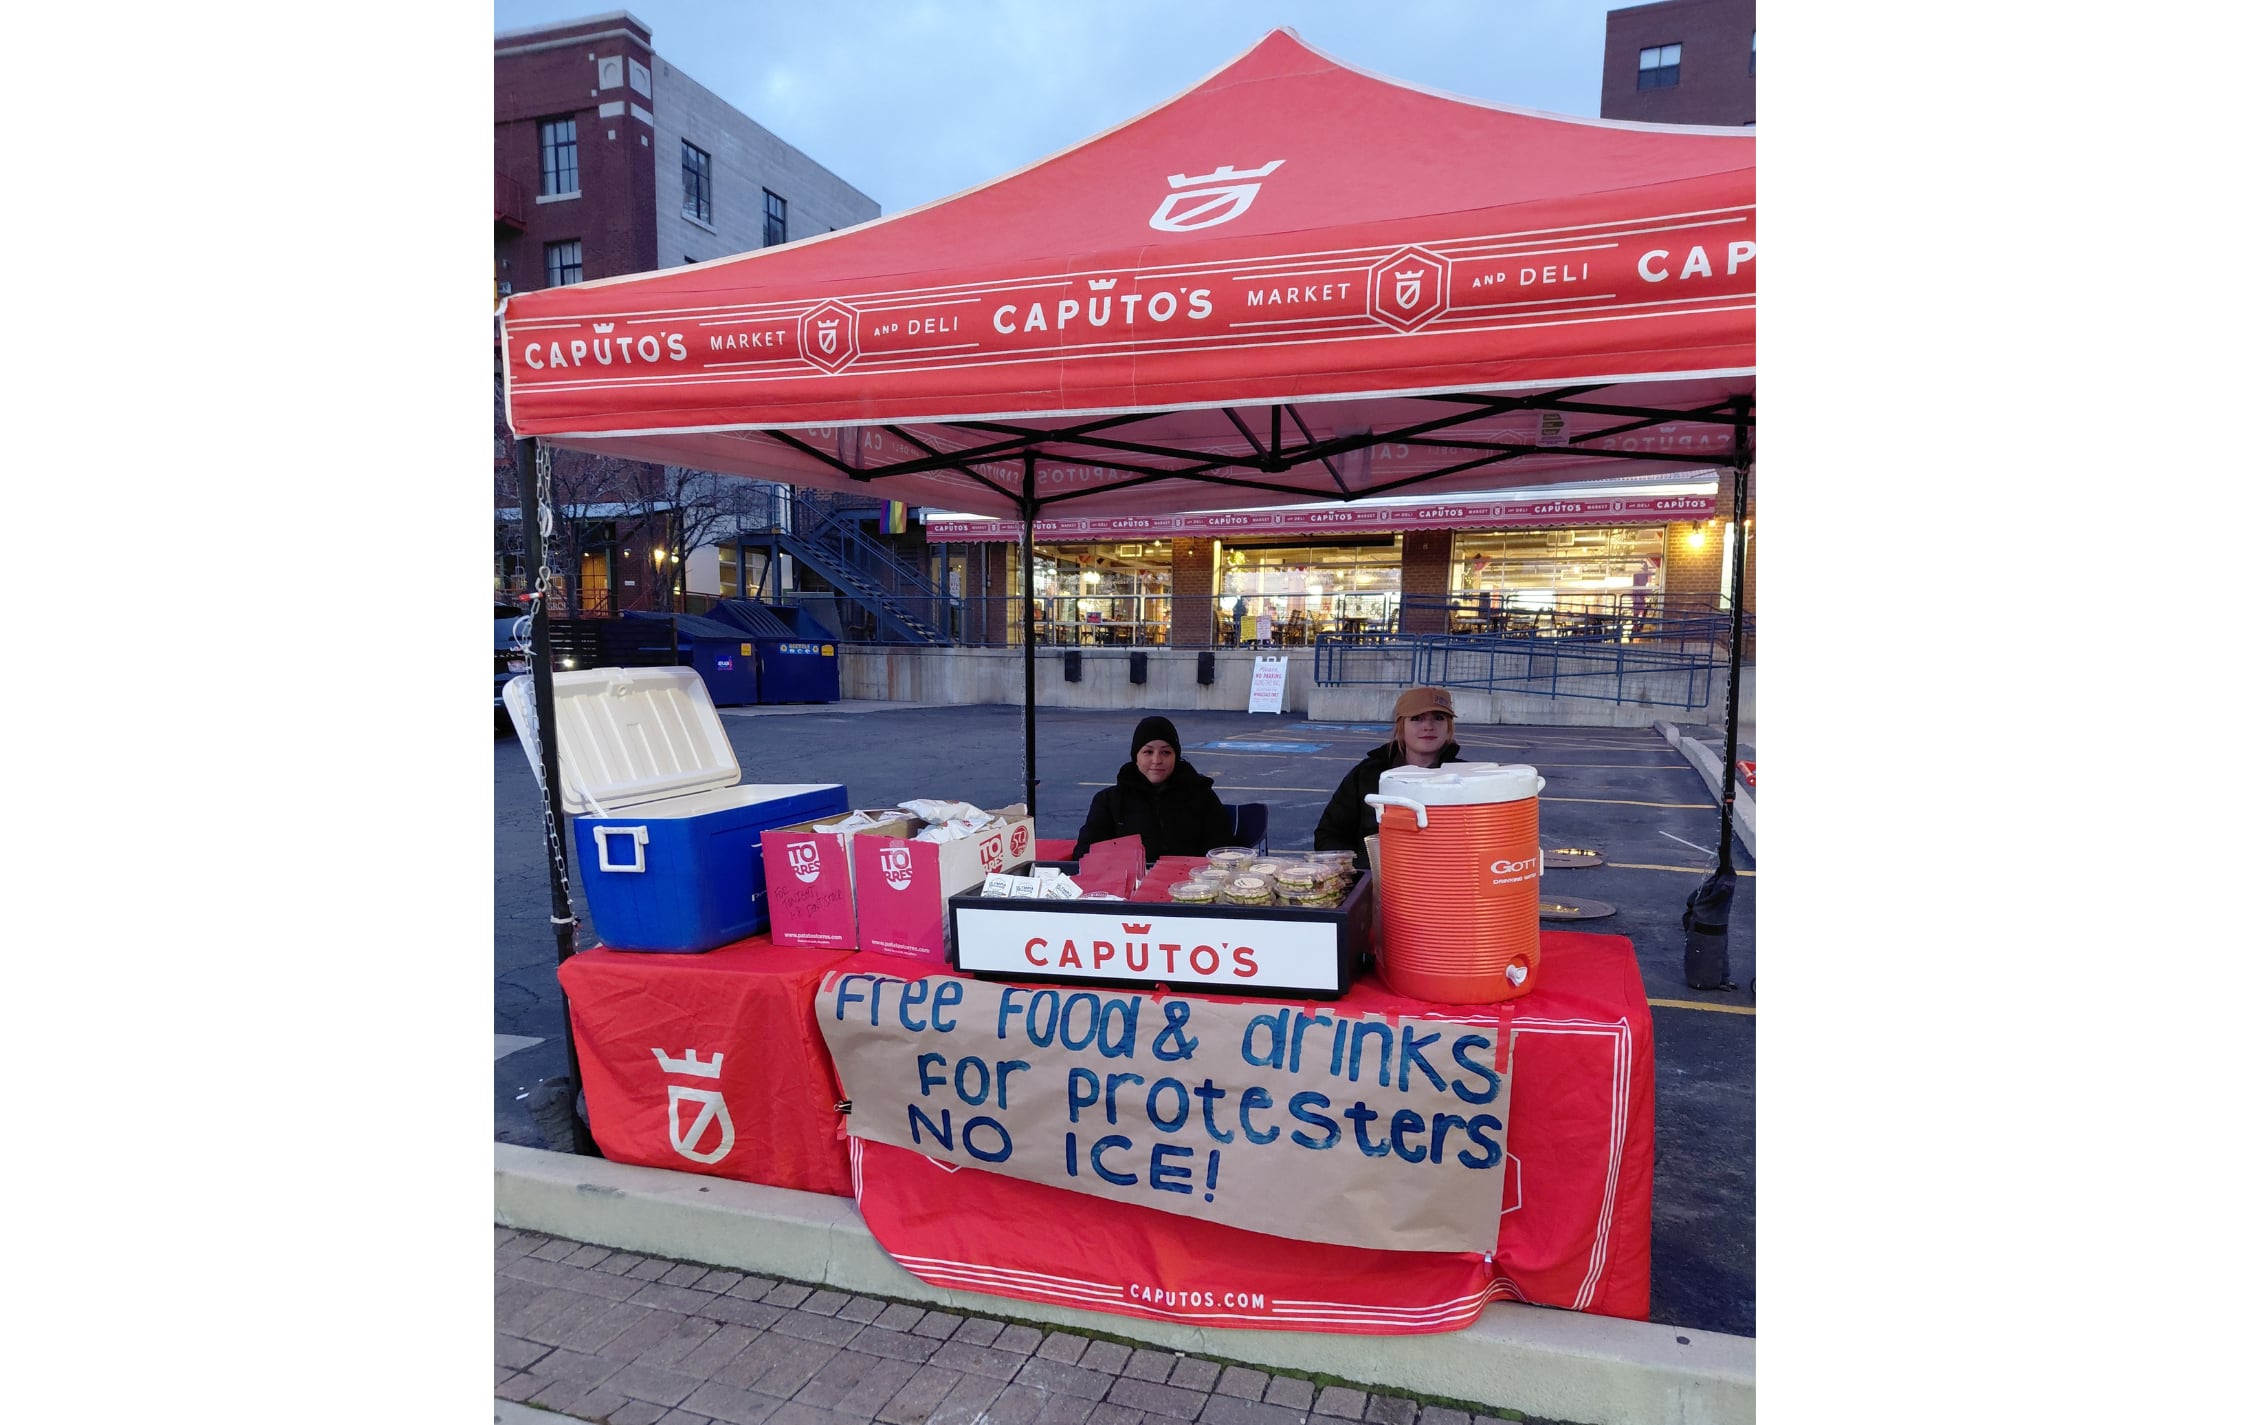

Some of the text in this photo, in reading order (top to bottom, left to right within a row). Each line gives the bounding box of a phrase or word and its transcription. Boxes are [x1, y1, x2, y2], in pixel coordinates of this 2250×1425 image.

[525, 332, 687, 369] CAPUTO'S
[711, 331, 786, 351] MARKET
[874, 323, 898, 337] AND
[908, 316, 958, 335] DELI
[993, 287, 1213, 334] CAPUTO'S
[1247, 282, 1351, 307] MARKET
[1472, 272, 1506, 288] AND
[1520, 263, 1589, 286] DELI
[1113, 520, 1149, 528] CAPUTO'S
[1209, 517, 1248, 525] CAPUTO'S
[1311, 513, 1352, 522] CAPUTO'S
[1419, 509, 1463, 518] CAPUTO'S
[1534, 504, 1581, 513] CAPUTO'S
[1656, 499, 1707, 509] CAPUTO'S
[787, 844, 817, 864] TO
[880, 849, 910, 869] TO
[980, 838, 1001, 861] TO
[794, 861, 820, 875] RRES
[884, 868, 912, 882] RRES
[1025, 937, 1259, 978] CAPUTO'S
[836, 973, 964, 1033] Free
[1152, 1001, 1200, 1062] &
[907, 1103, 1221, 1204] NO ICE!
[1130, 1283, 1264, 1309] CAPUTOS.COM
